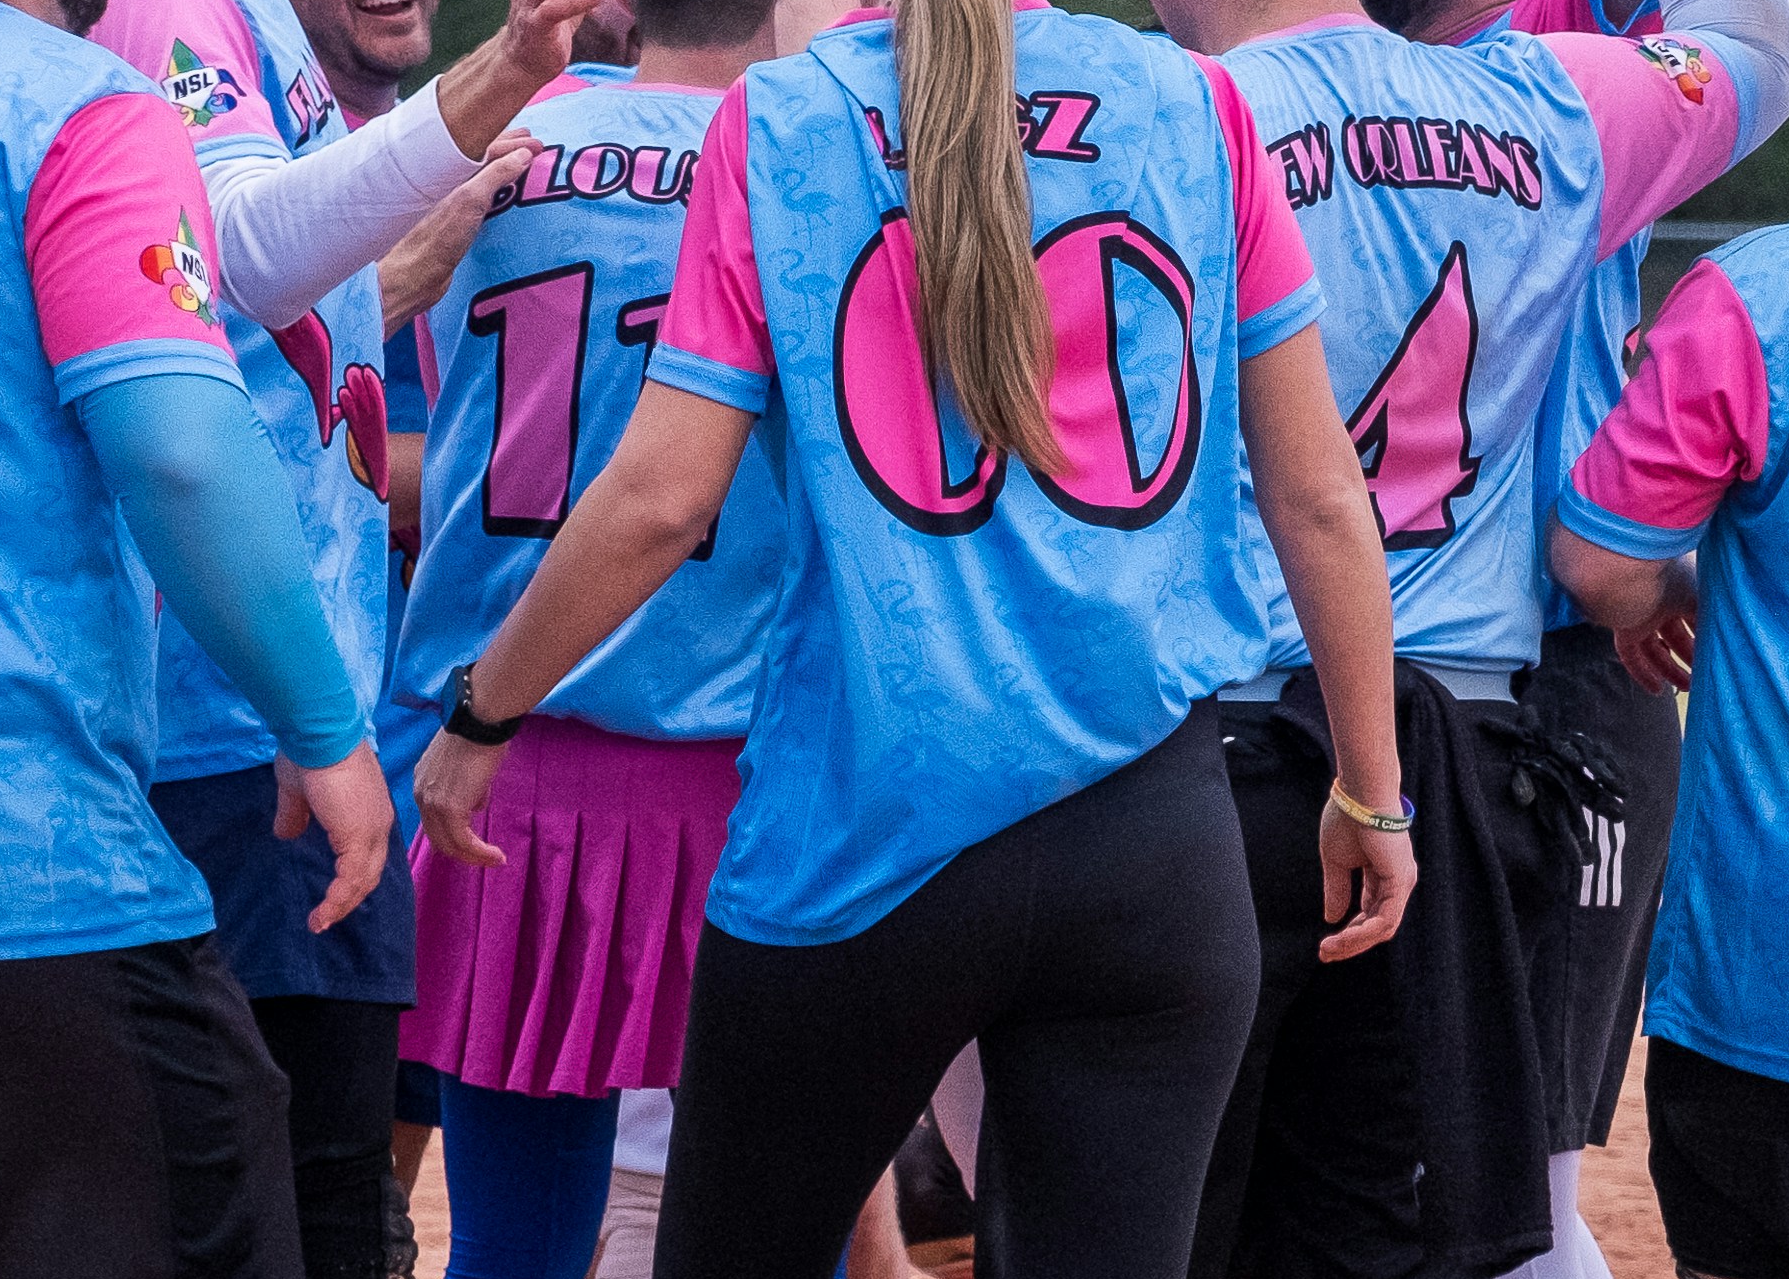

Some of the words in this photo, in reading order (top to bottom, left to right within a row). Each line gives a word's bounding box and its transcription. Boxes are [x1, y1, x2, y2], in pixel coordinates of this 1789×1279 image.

[173, 71, 214, 101] NSL
[483, 142, 701, 222] LOU
[1266, 121, 1335, 211] EW
[1342, 113, 1543, 211] ORLEANS
